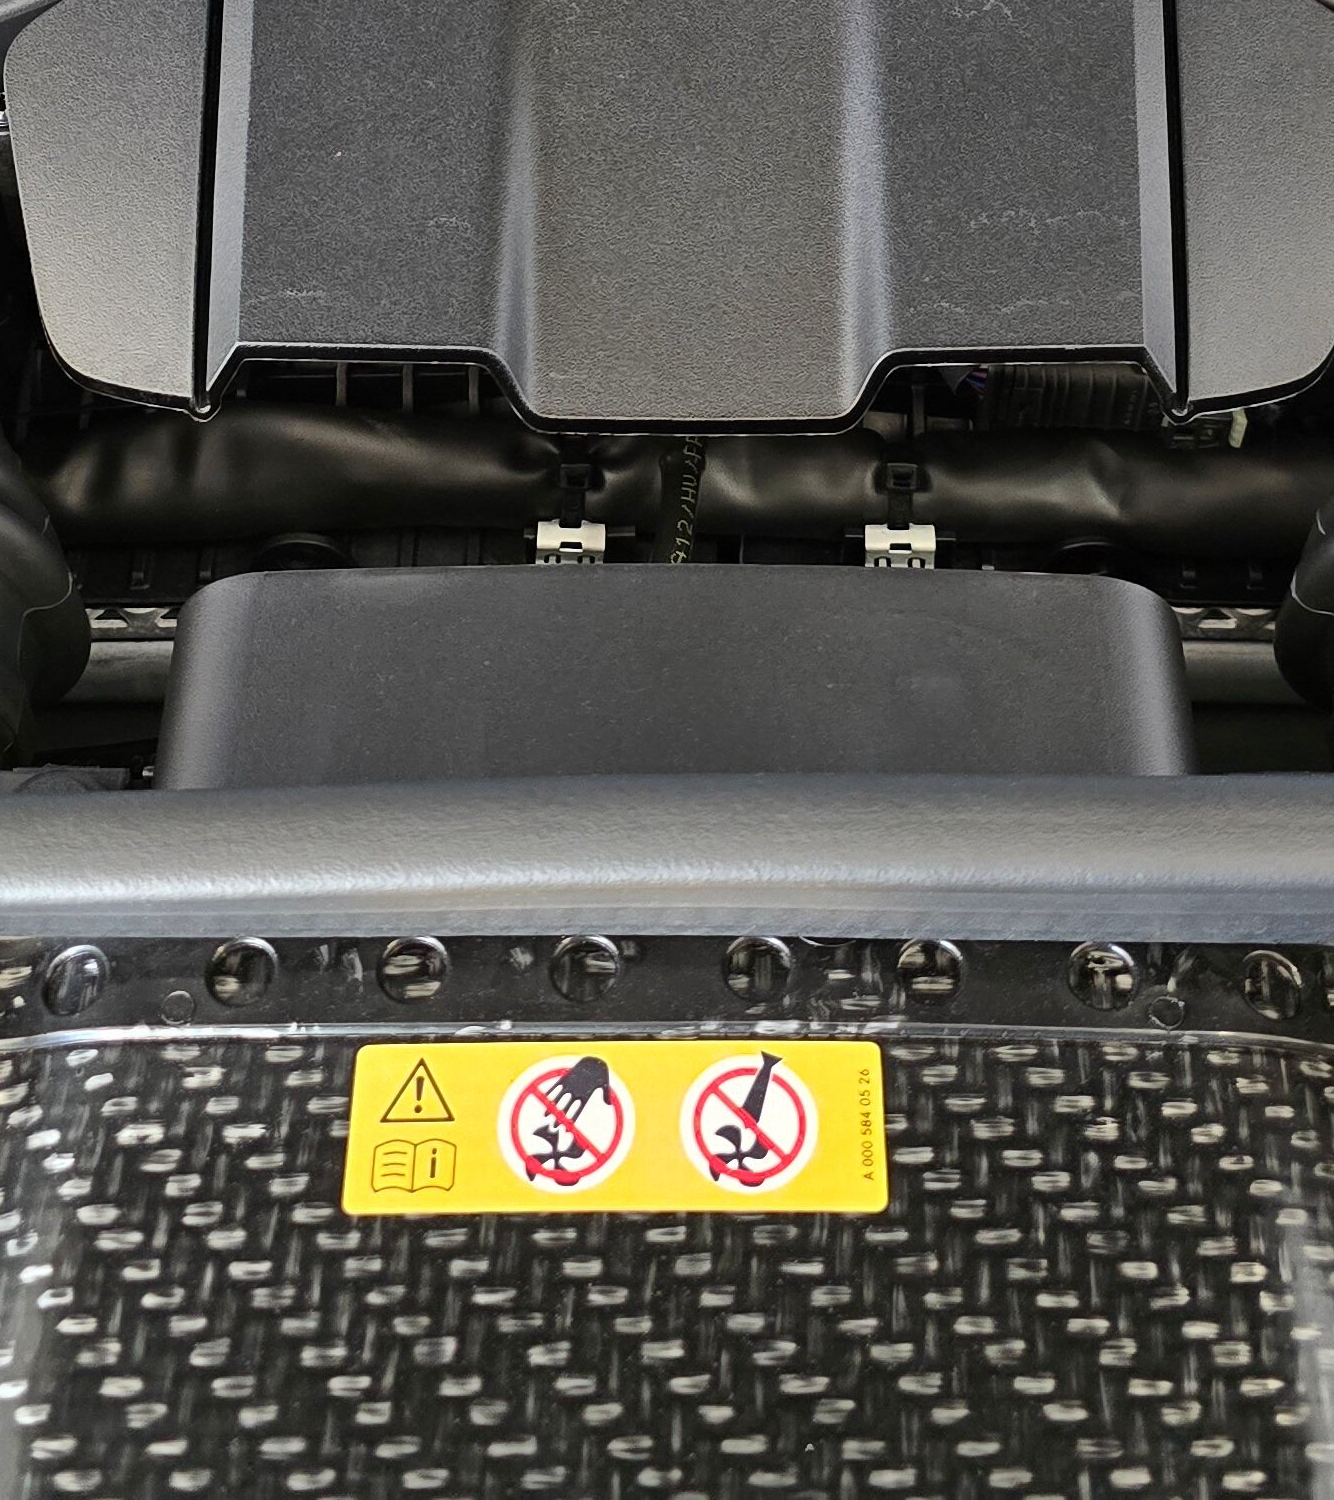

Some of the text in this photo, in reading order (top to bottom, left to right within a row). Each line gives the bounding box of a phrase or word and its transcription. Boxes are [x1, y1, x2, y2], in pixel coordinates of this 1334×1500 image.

[858, 1068, 875, 1181] A 000 584 05 26
